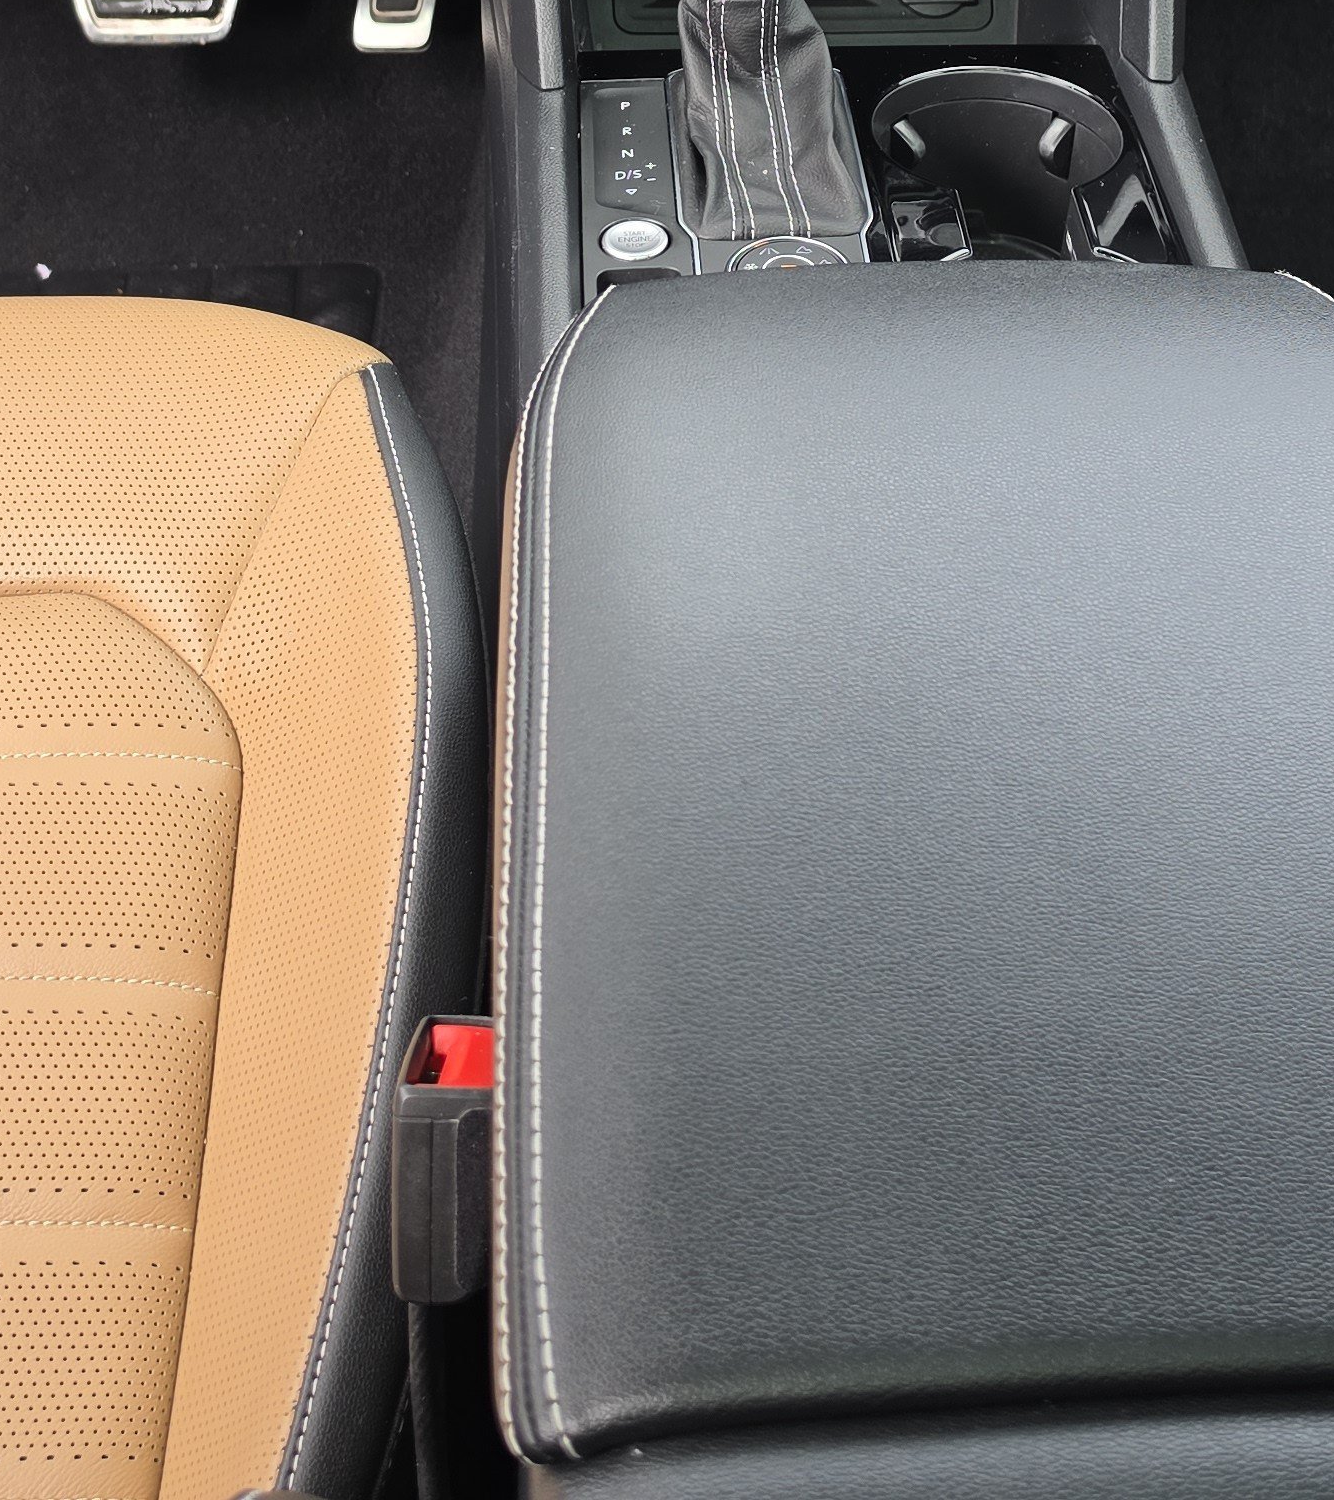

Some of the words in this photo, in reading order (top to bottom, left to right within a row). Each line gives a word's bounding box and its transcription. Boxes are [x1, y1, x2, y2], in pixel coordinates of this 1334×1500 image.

[620, 101, 631, 111] P
[622, 126, 633, 136] R
[621, 148, 635, 158] N
[614, 169, 643, 181] D/S
[617, 235, 653, 243] ENGINE
